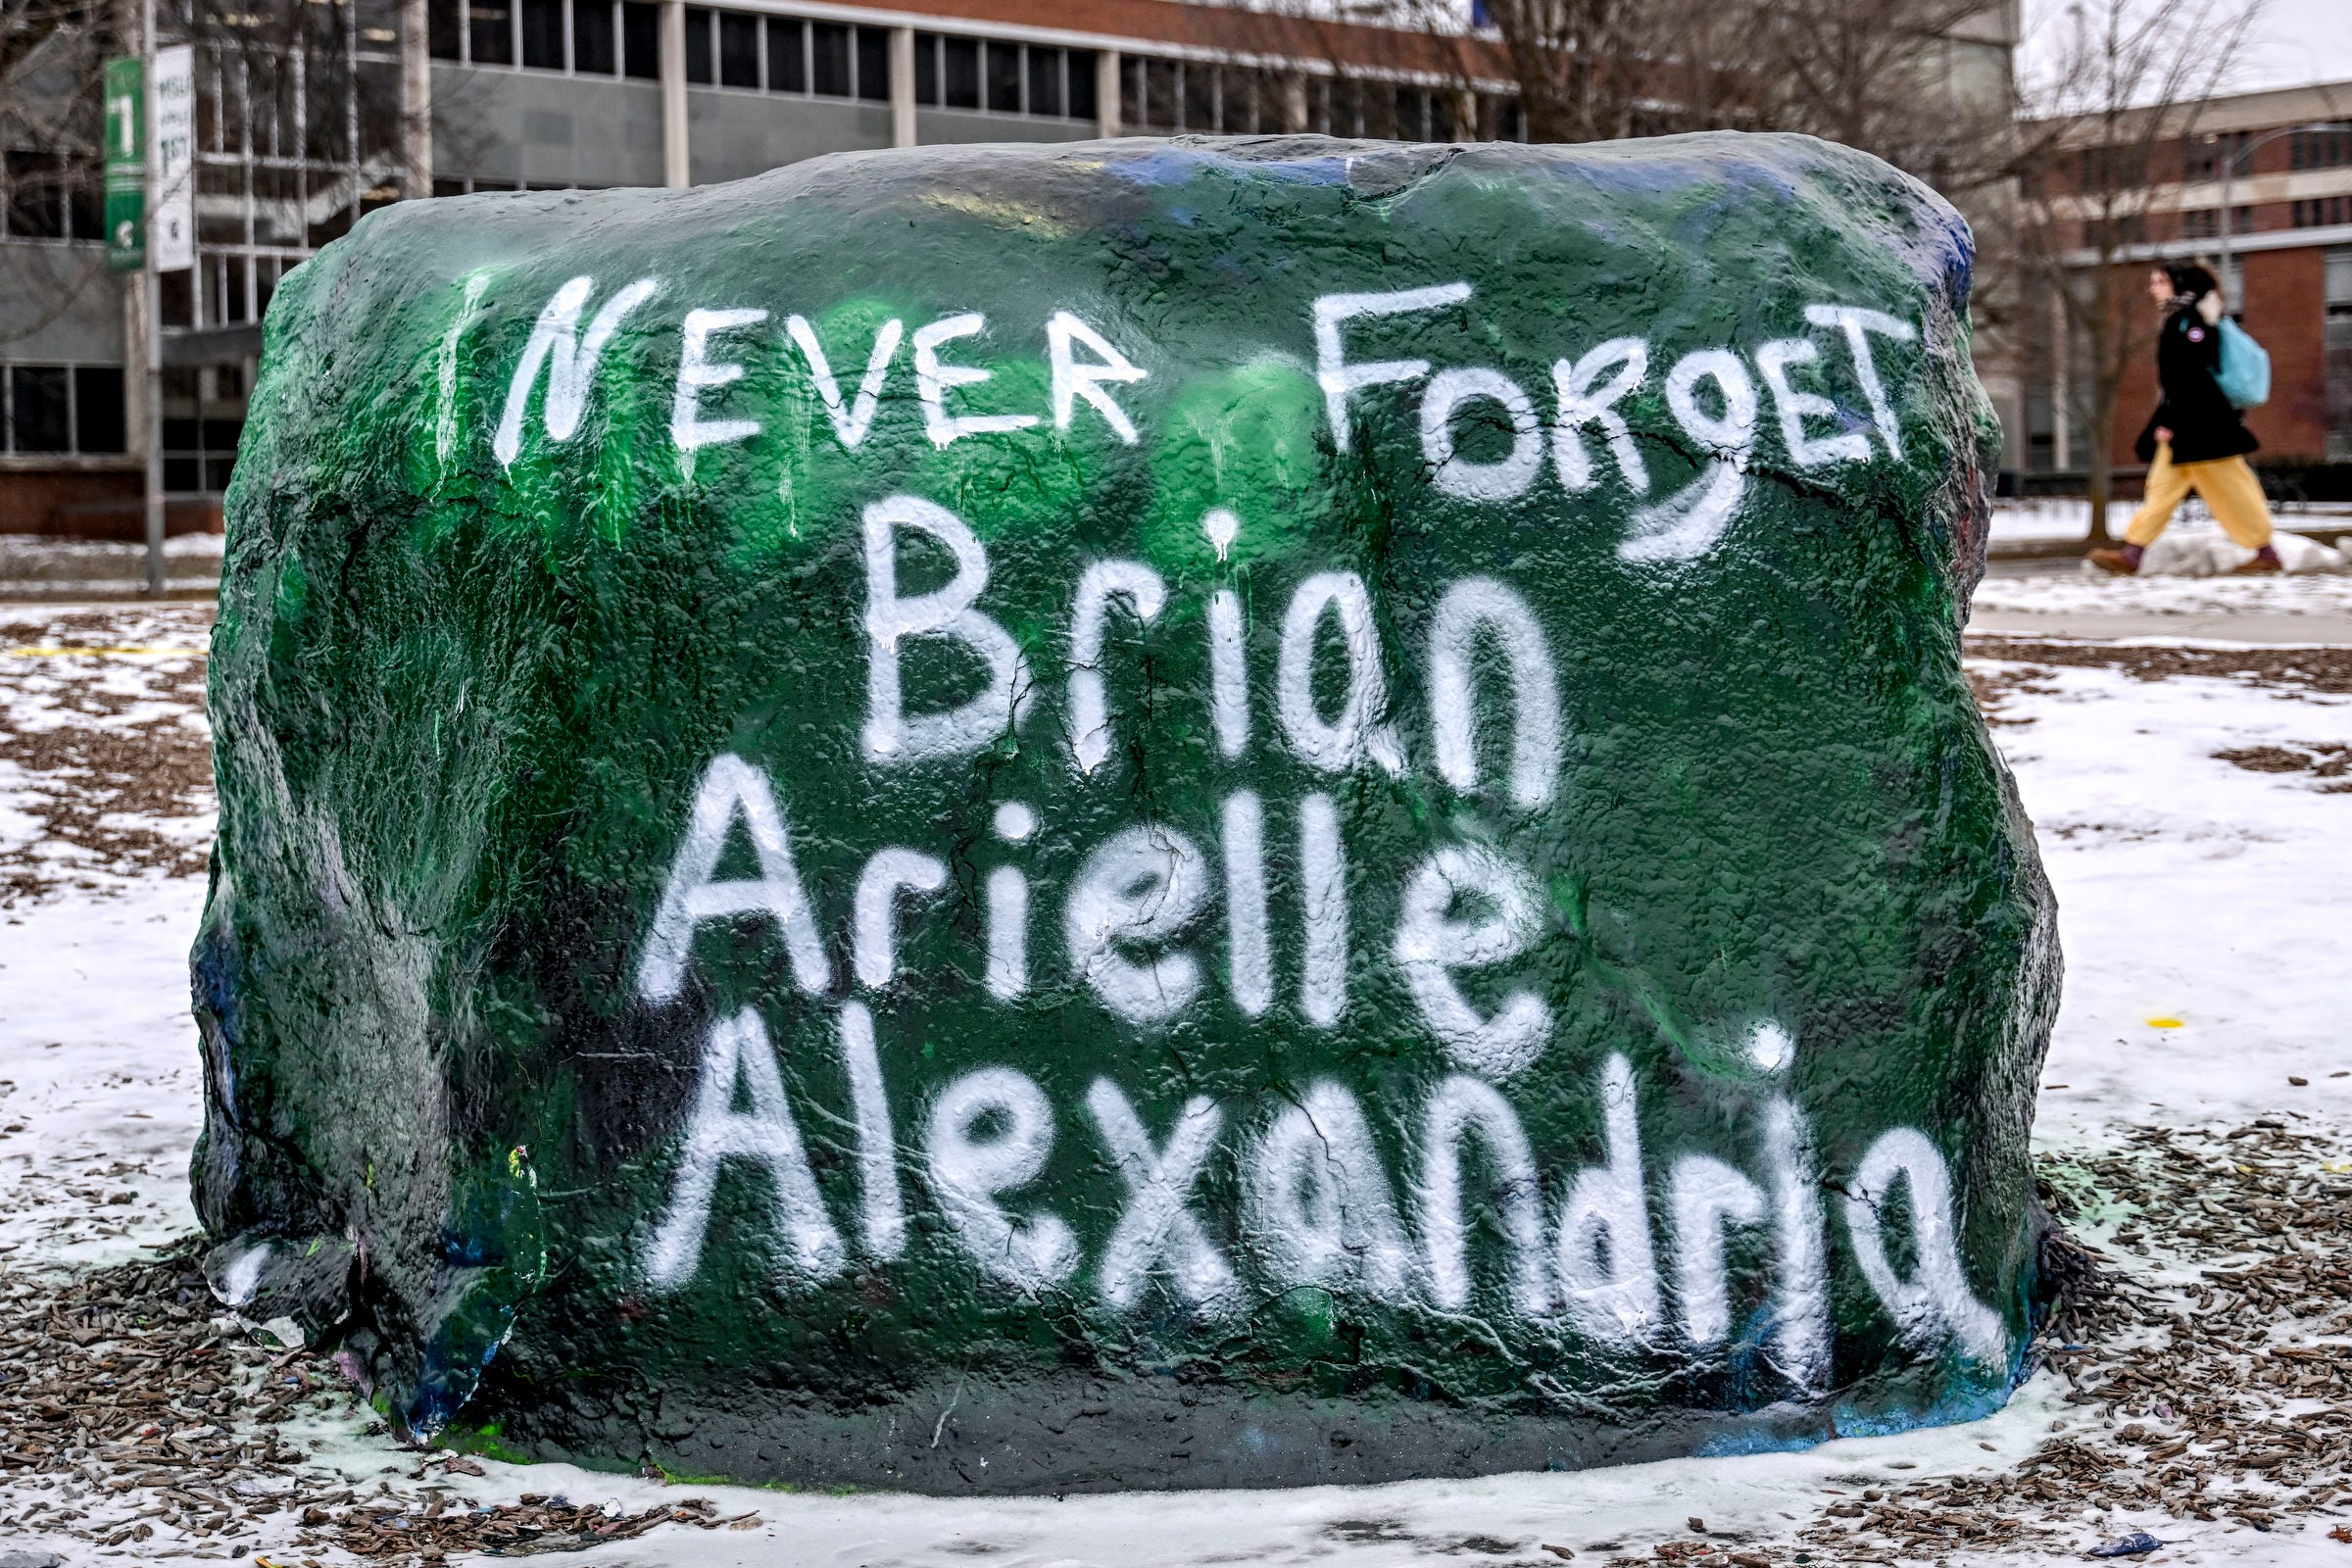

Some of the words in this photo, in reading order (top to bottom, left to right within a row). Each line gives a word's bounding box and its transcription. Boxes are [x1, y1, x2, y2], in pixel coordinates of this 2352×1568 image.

[493, 275, 1149, 467] NEVER
[860, 493, 1566, 809] Brian
[637, 753, 1553, 1078] Arielle
[641, 1002, 2009, 1387] Alexandria
